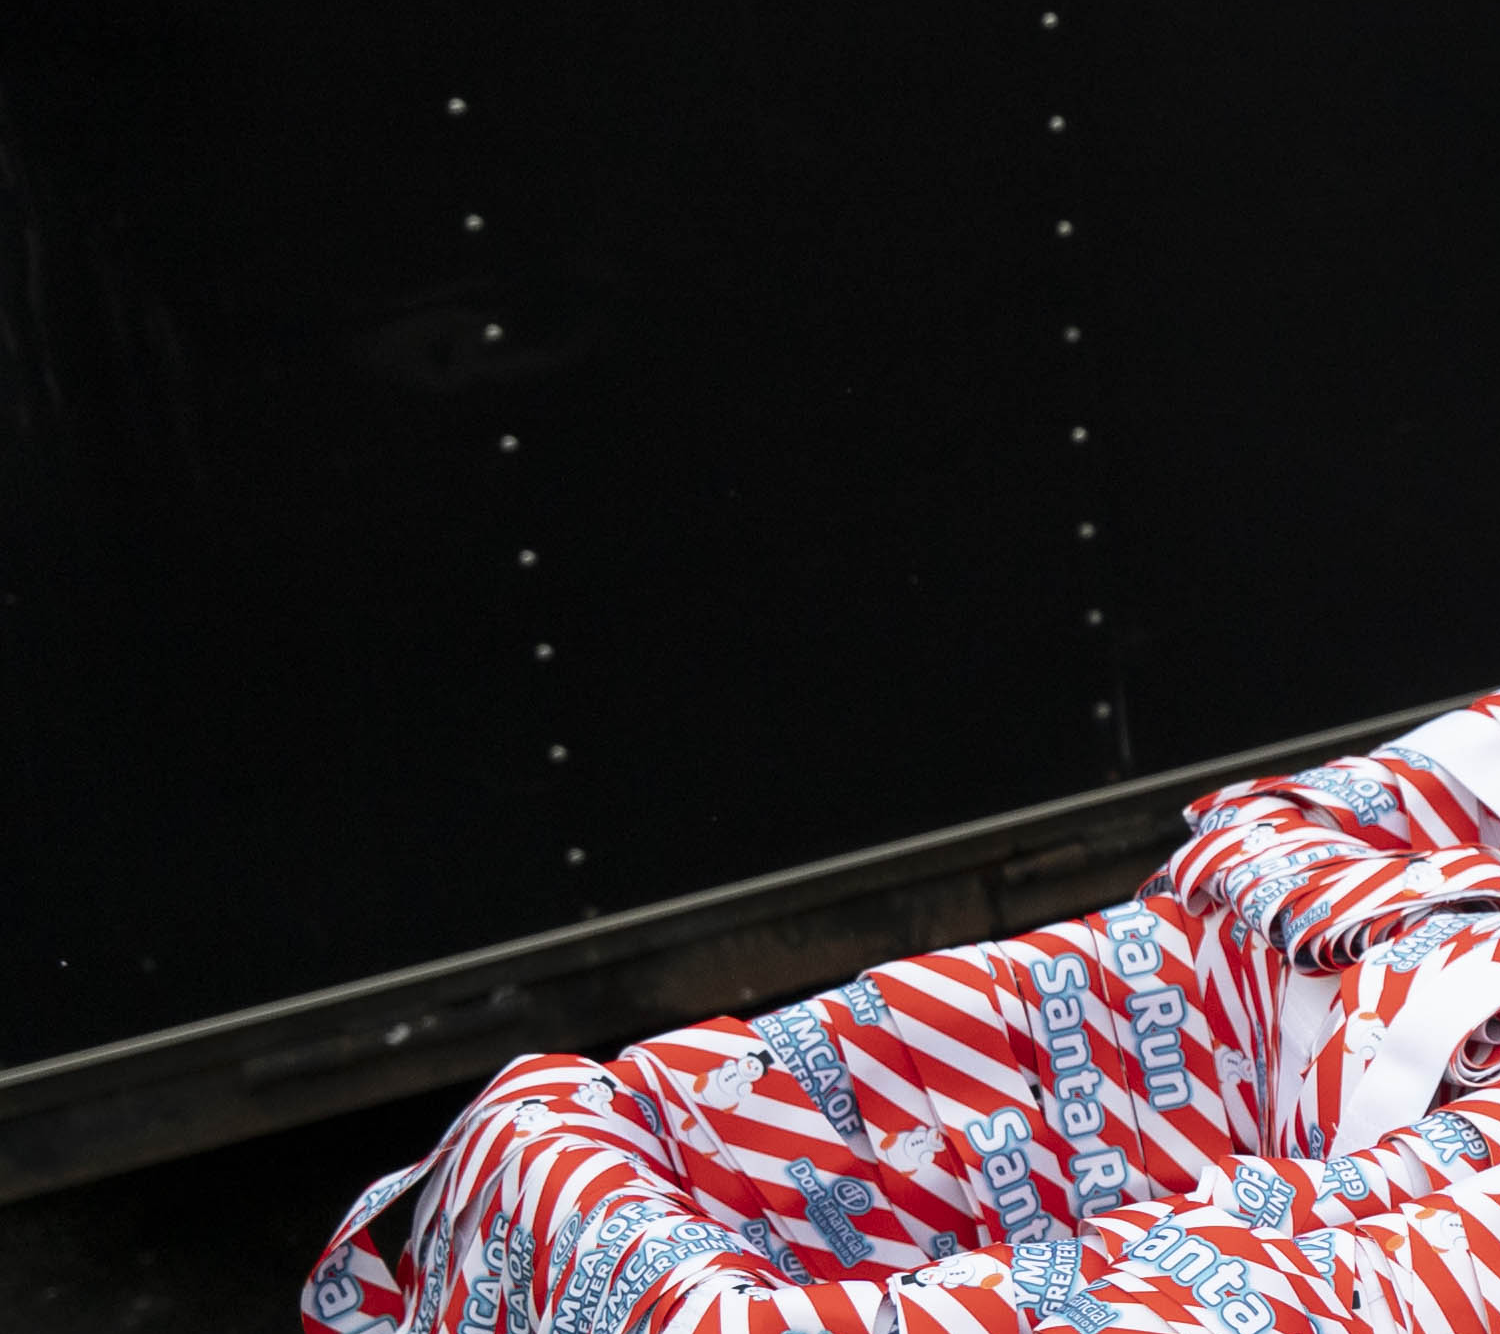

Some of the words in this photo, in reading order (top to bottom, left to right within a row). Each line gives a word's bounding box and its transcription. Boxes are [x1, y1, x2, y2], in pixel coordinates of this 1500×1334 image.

[1354, 776, 1396, 819] OF
[1035, 955, 1103, 1139] Santa
[1131, 988, 1192, 1108] Run
[780, 1005, 834, 1090] YMCA
[825, 1097, 860, 1137] OF
[790, 1161, 824, 1201] Dort
[820, 1195, 870, 1260] Financial
[834, 1179, 871, 1214] df
[1239, 1170, 1263, 1210] OF
[600, 1204, 646, 1242] OF
[675, 1223, 725, 1242] OF
[512, 1230, 527, 1284] OF
[671, 1235, 742, 1261] FLINT
